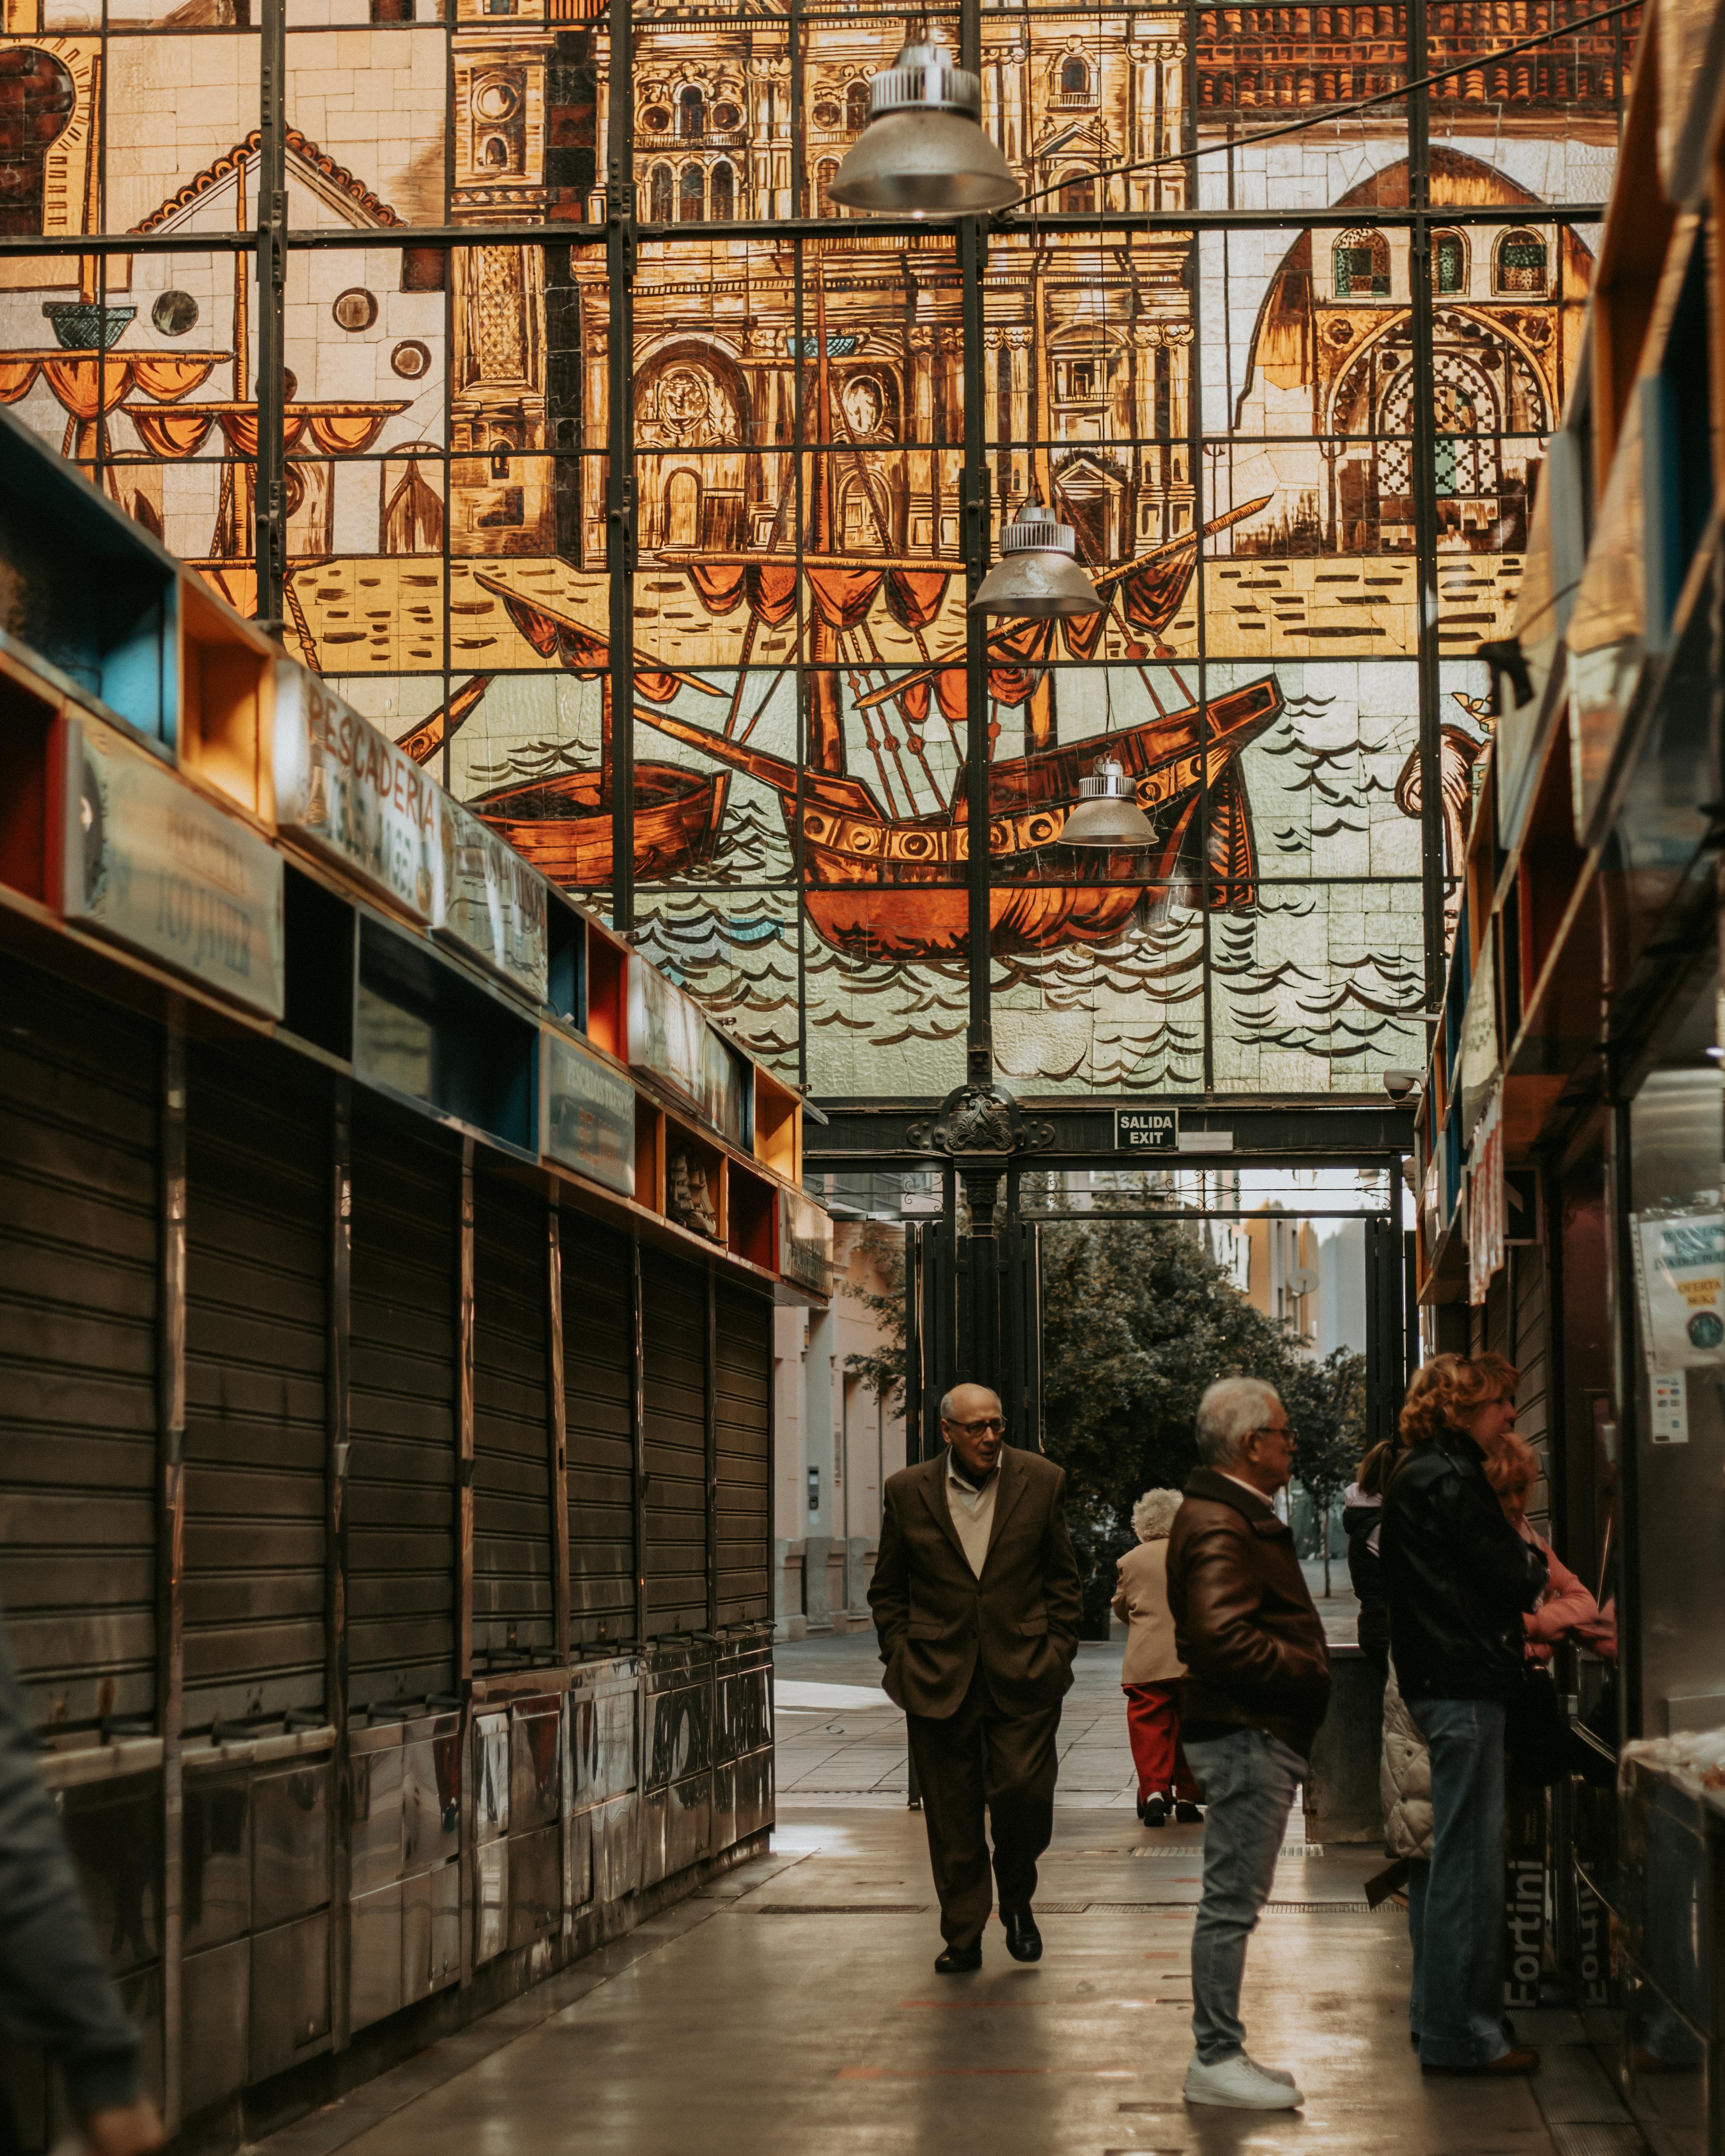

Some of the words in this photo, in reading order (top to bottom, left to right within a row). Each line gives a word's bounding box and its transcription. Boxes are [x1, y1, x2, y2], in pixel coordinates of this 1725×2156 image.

[307, 682, 434, 841] PESCADERIA
[1120, 1116, 1173, 1129] SALIDA
[1130, 1132, 1163, 1144] EXIT
[1679, 1280, 1721, 1292] OFERTA
[1503, 1860, 1543, 2008] Fortini
